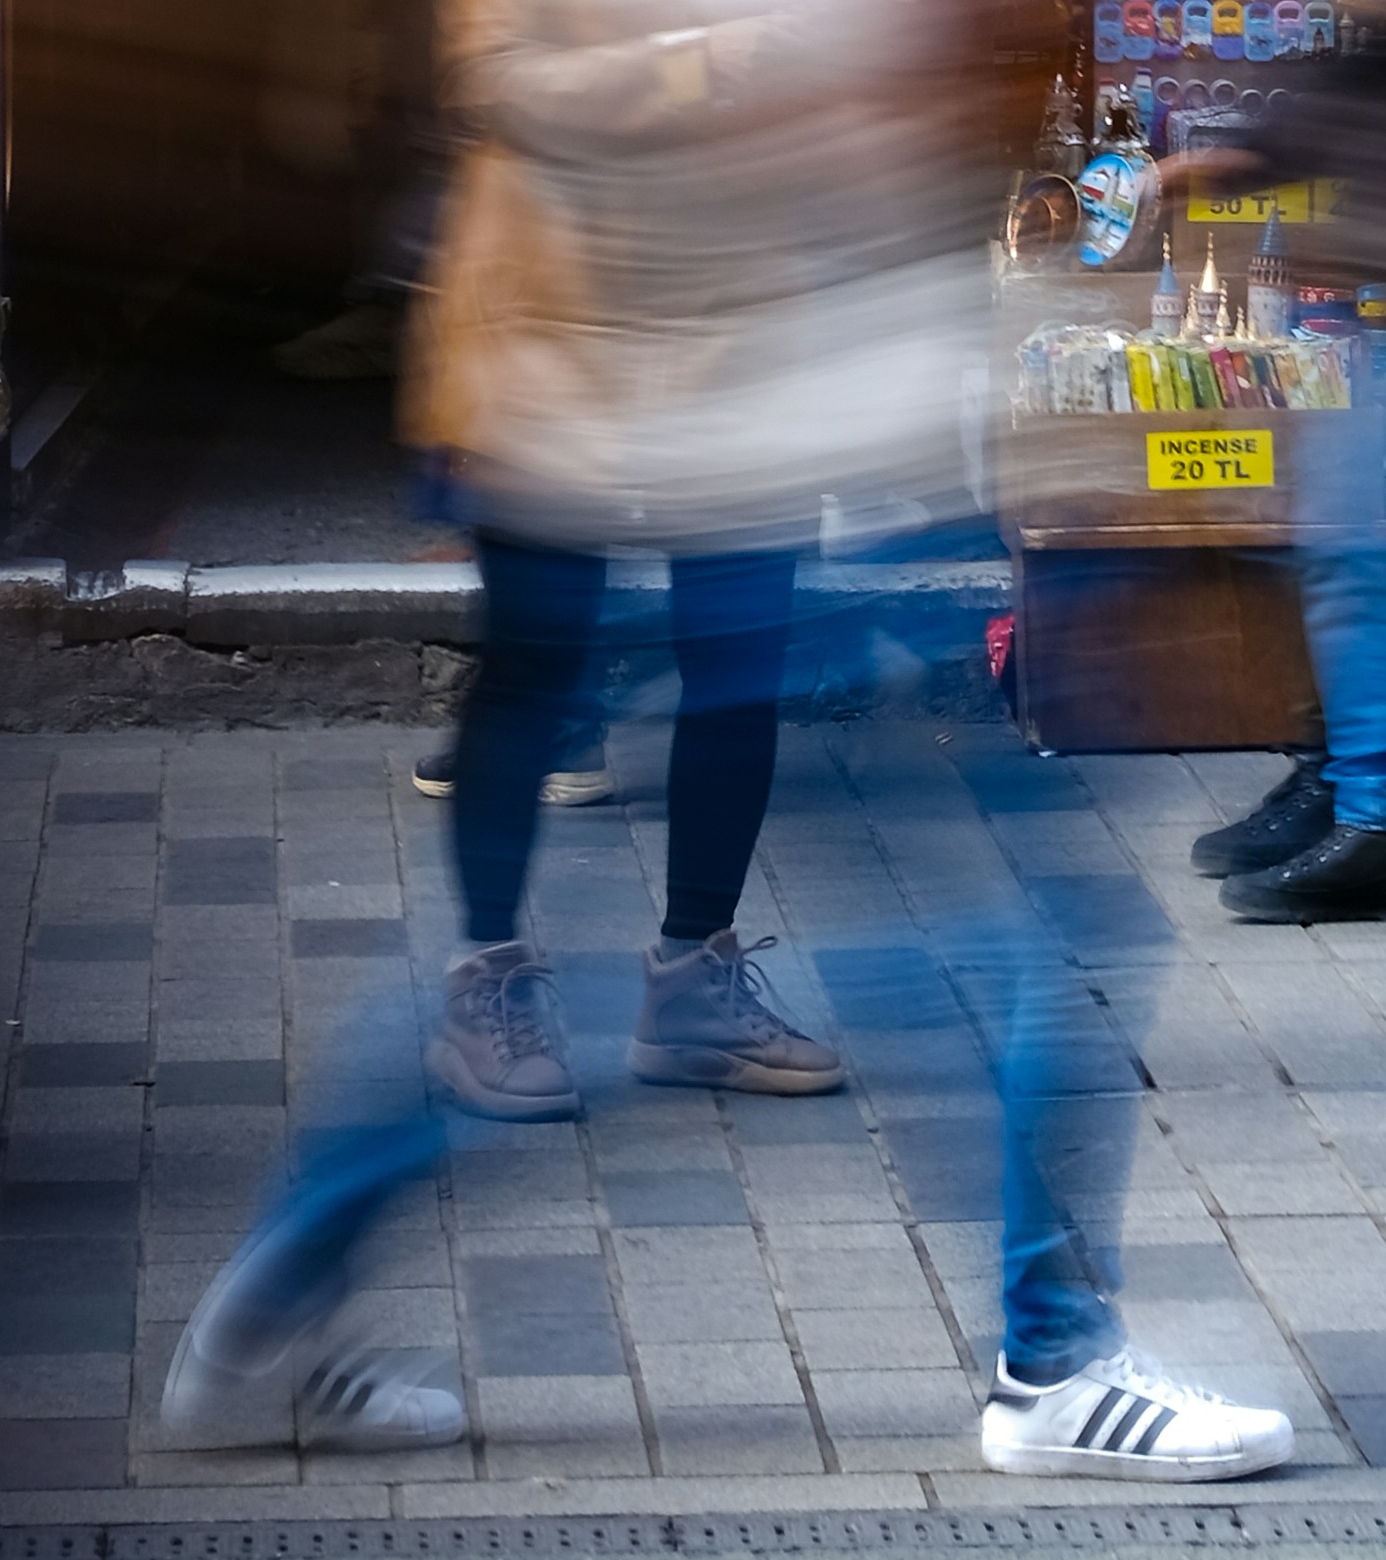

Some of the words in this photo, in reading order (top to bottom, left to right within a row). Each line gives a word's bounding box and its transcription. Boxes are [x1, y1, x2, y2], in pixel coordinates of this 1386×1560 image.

[1159, 439, 1258, 455] INCENSE
[1170, 459, 1204, 480] 20
[1213, 459, 1251, 479] TL
